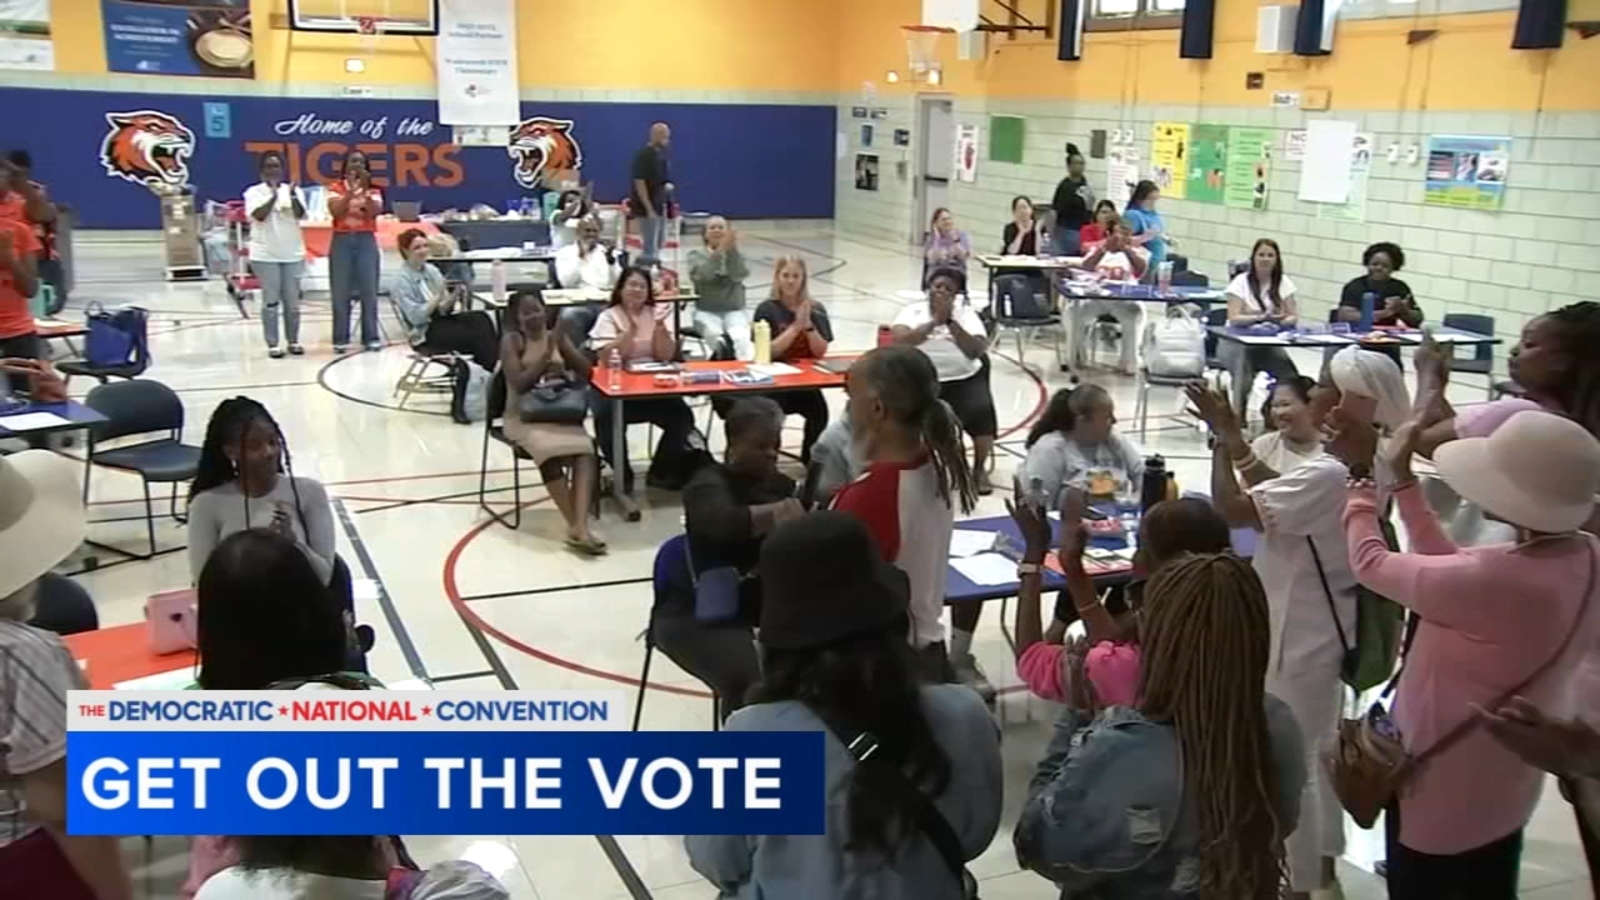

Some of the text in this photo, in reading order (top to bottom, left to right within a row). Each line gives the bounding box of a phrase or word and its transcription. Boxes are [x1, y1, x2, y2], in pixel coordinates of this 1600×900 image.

[275, 113, 434, 139] Home of the
